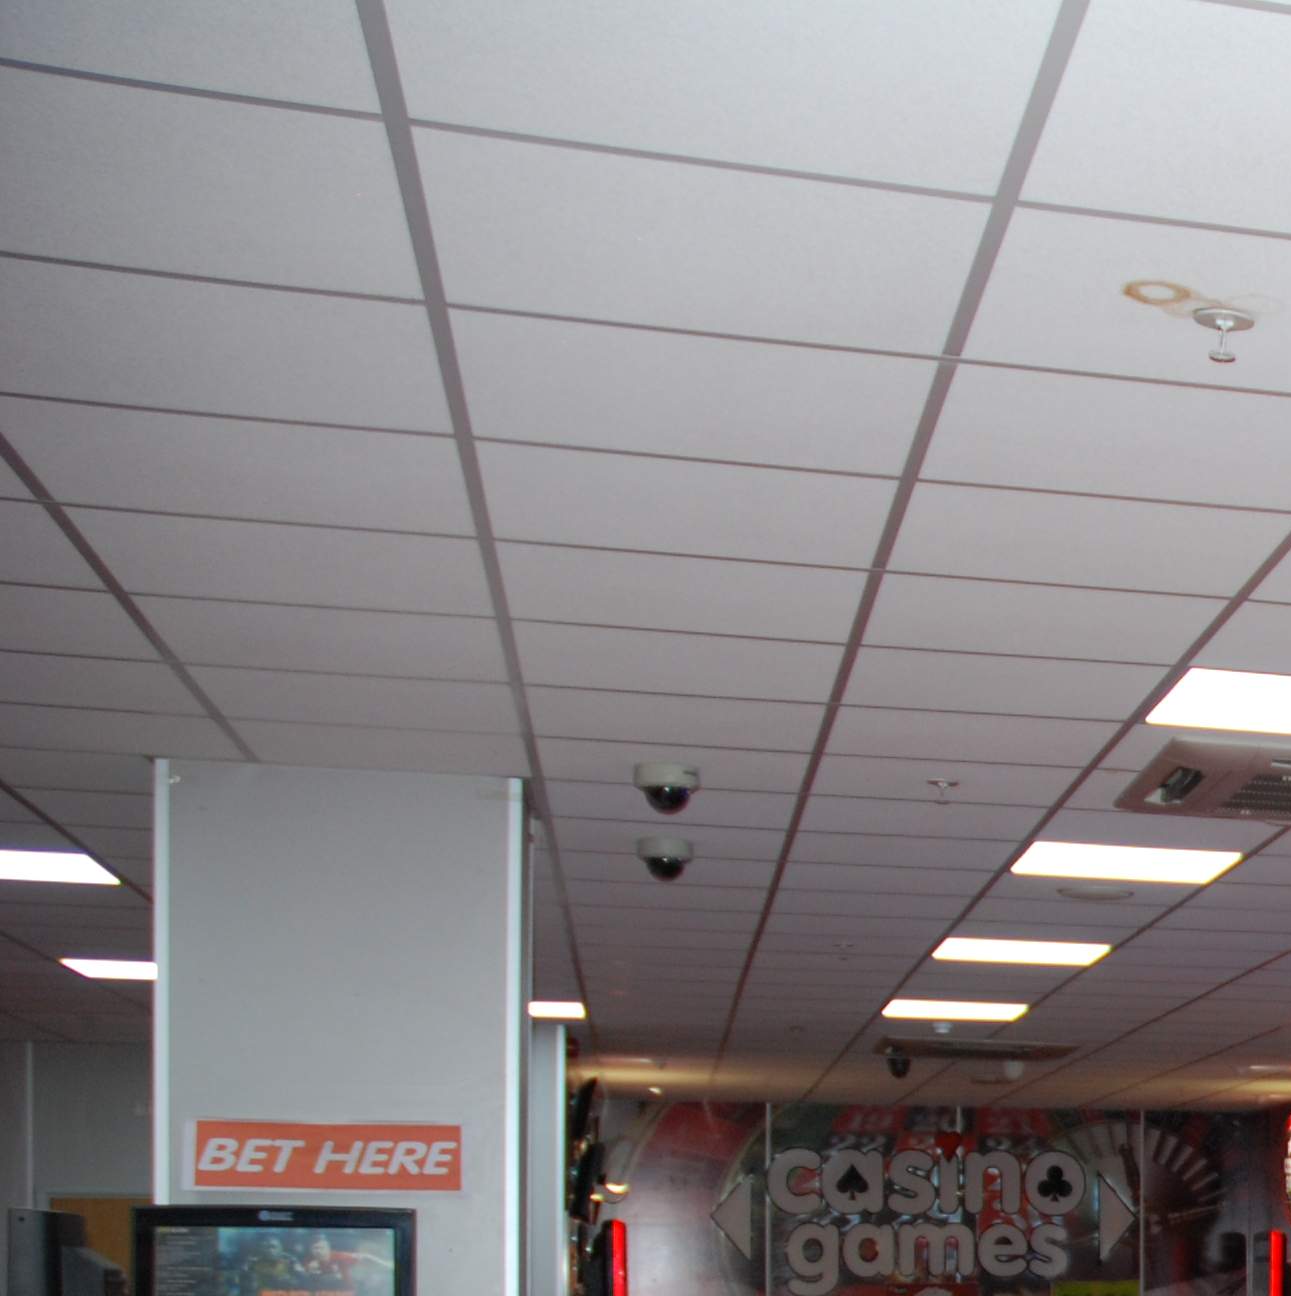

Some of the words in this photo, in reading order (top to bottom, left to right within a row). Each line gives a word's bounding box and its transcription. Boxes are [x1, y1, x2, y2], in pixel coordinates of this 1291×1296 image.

[198, 1137, 305, 1173] BET
[313, 1140, 457, 1176] HERE
[767, 1132, 1086, 1216] casino
[786, 1222, 1067, 1296] games
